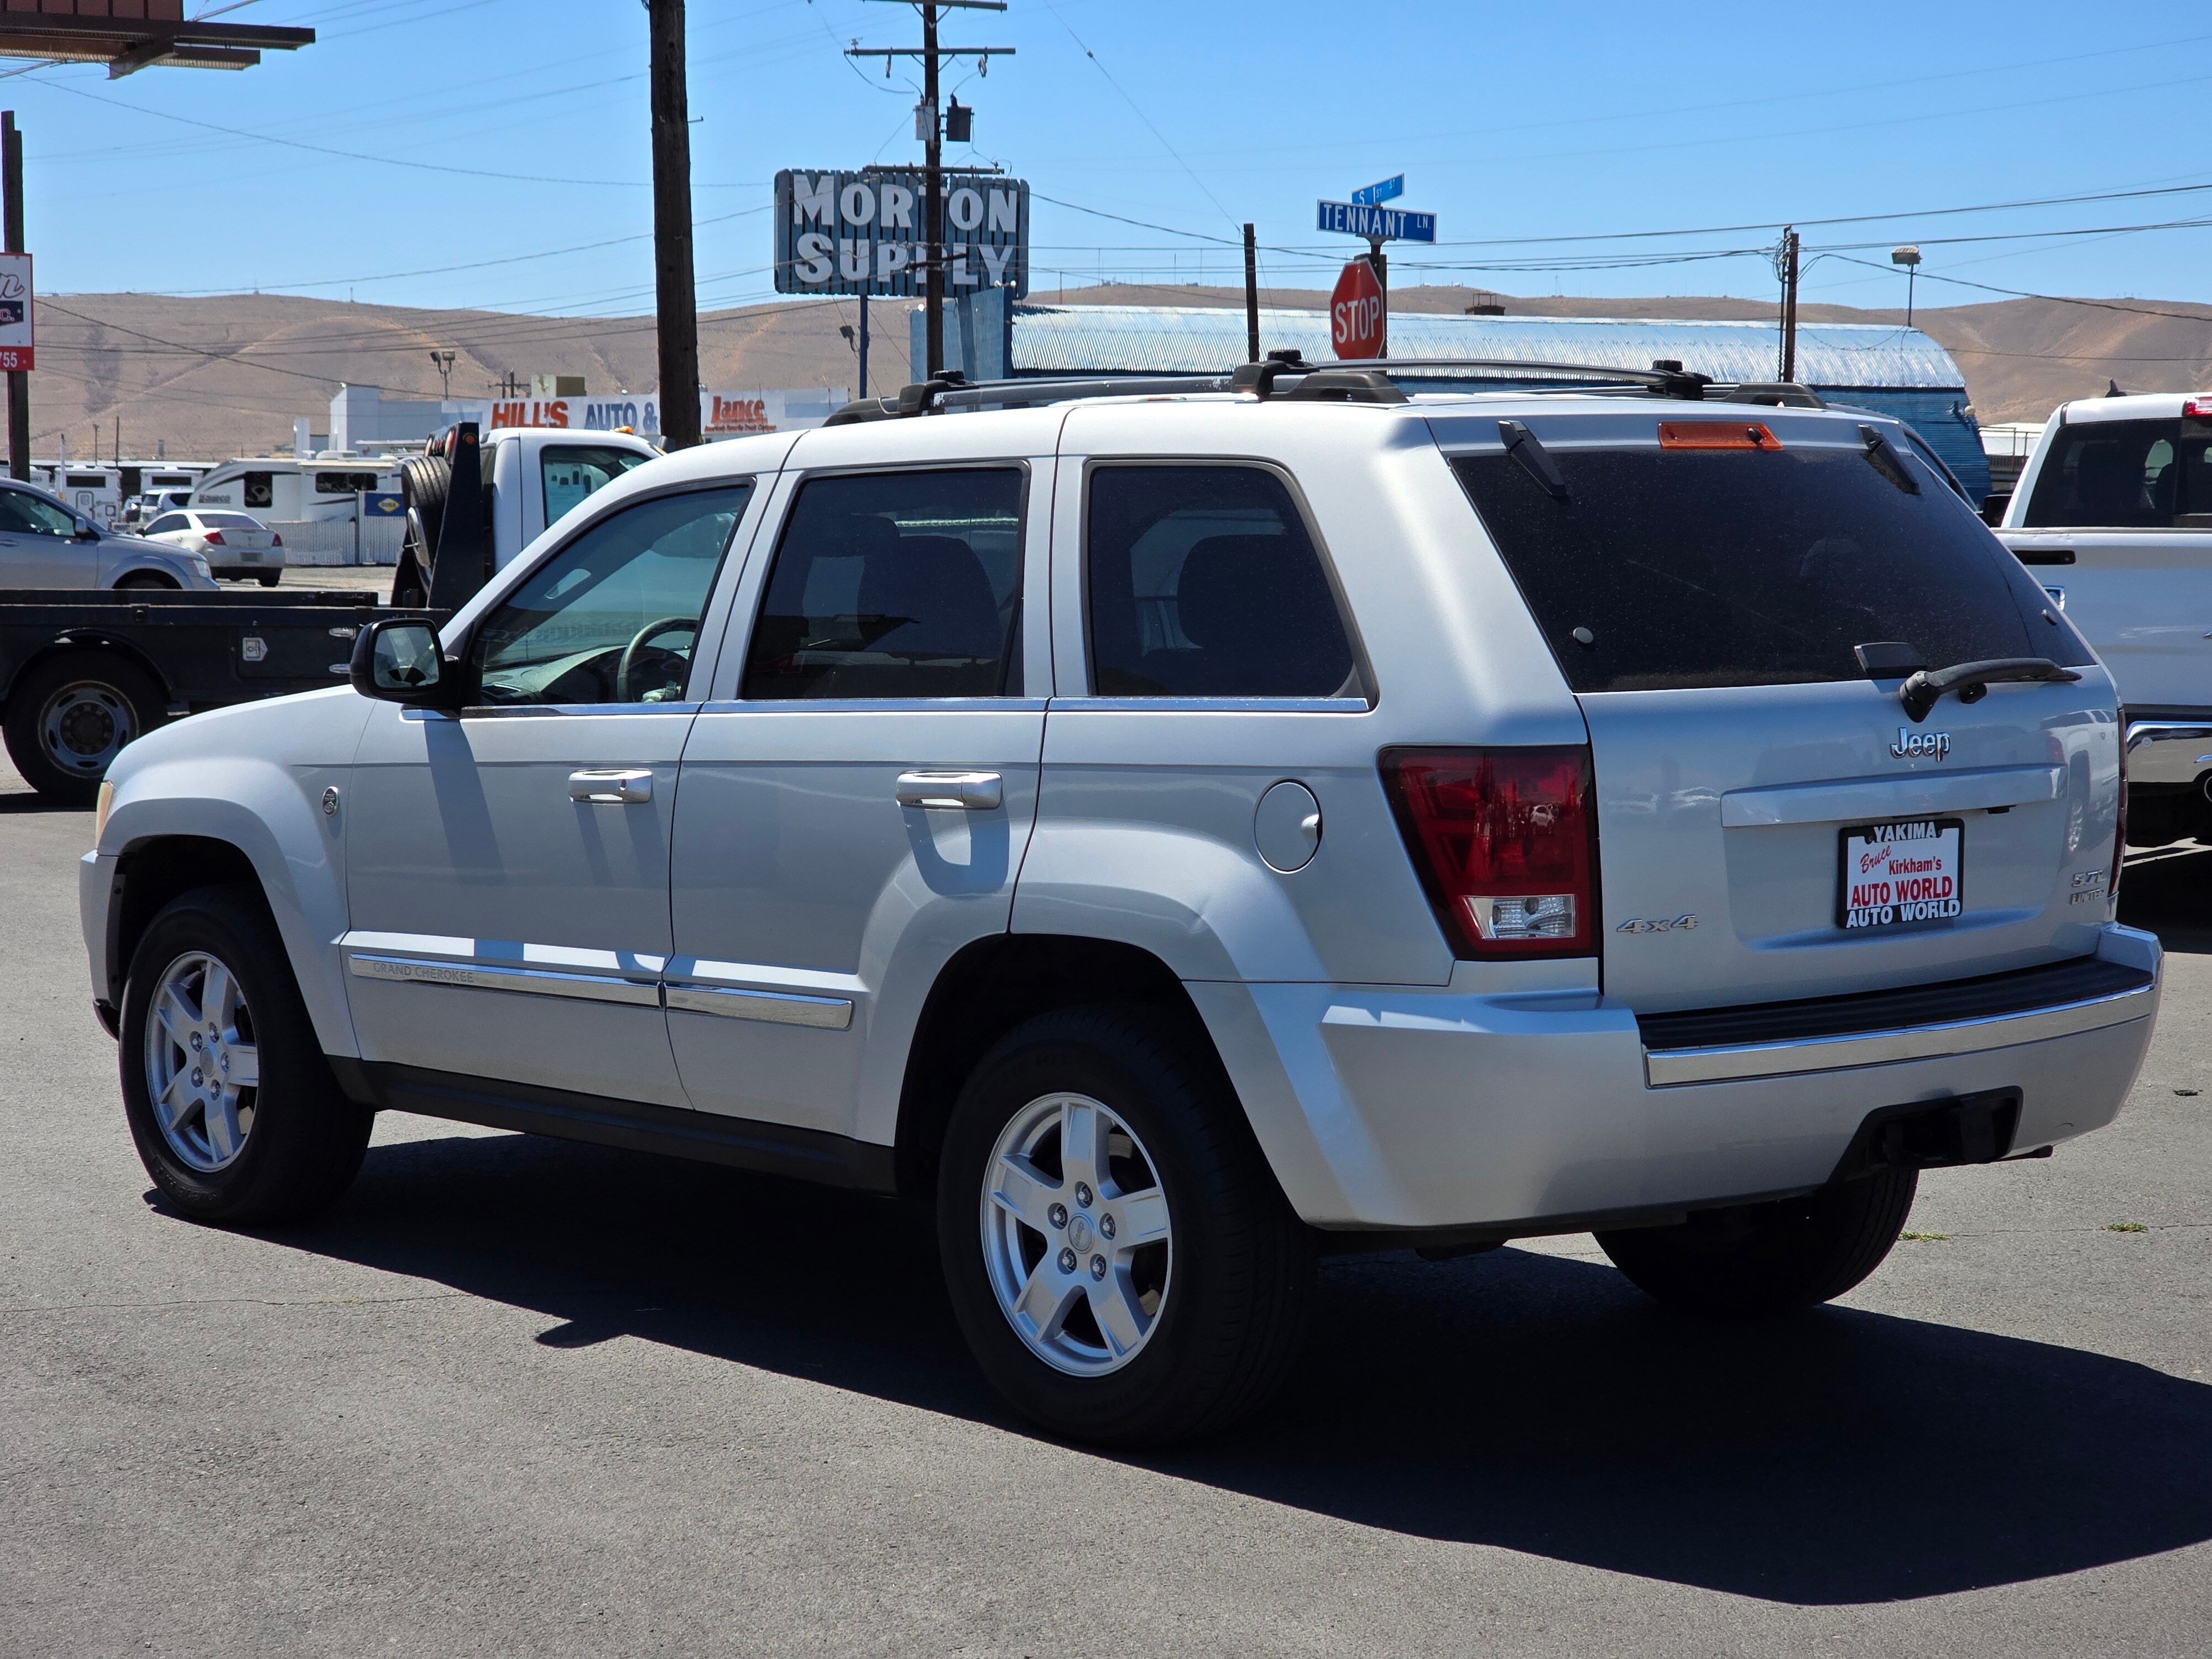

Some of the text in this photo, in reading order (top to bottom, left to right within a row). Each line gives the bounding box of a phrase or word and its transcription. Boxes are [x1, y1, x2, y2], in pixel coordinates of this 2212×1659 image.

[1359, 190, 1365, 205] S
[1389, 179, 1395, 189] ST
[1323, 204, 1406, 237] TENNANT
[1335, 295, 1379, 343] STOP
[491, 400, 658, 431] HILL'S AUTO &
[1890, 727, 1950, 762] Jeep
[1874, 821, 1937, 843] YAKIMA
[1860, 844, 1891, 874] Bruce
[1889, 856, 1942, 875] Kirkham's
[1851, 876, 1953, 907] AUTO WORLD
[1616, 914, 1699, 933] 4x4
[1846, 899, 1960, 928] AUTO WORLD
[373, 962, 474, 983] GRAND CHEROKEE
